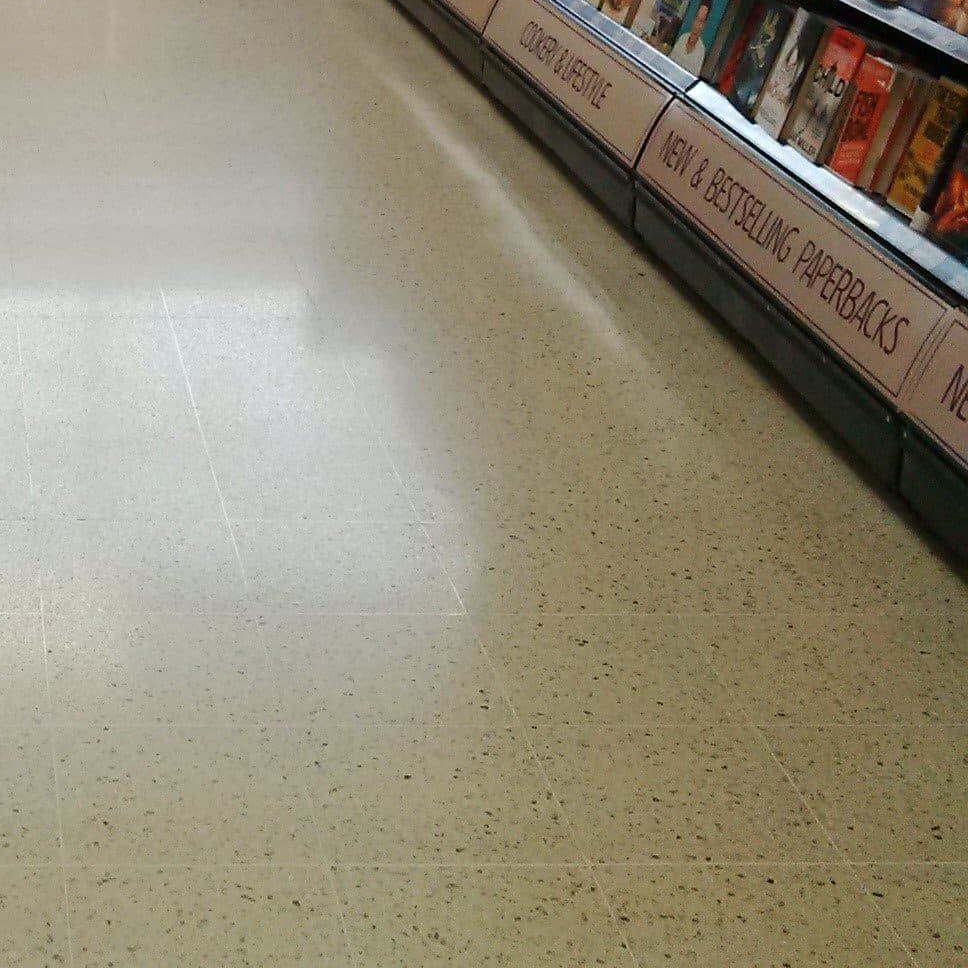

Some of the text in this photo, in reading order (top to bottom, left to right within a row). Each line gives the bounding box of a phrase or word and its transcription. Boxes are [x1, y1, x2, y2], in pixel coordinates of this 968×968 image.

[520, 21, 612, 109] COOKERY & LIFESTYLE
[659, 130, 910, 355] NEW & BESTSELLING PAPERBACKS
